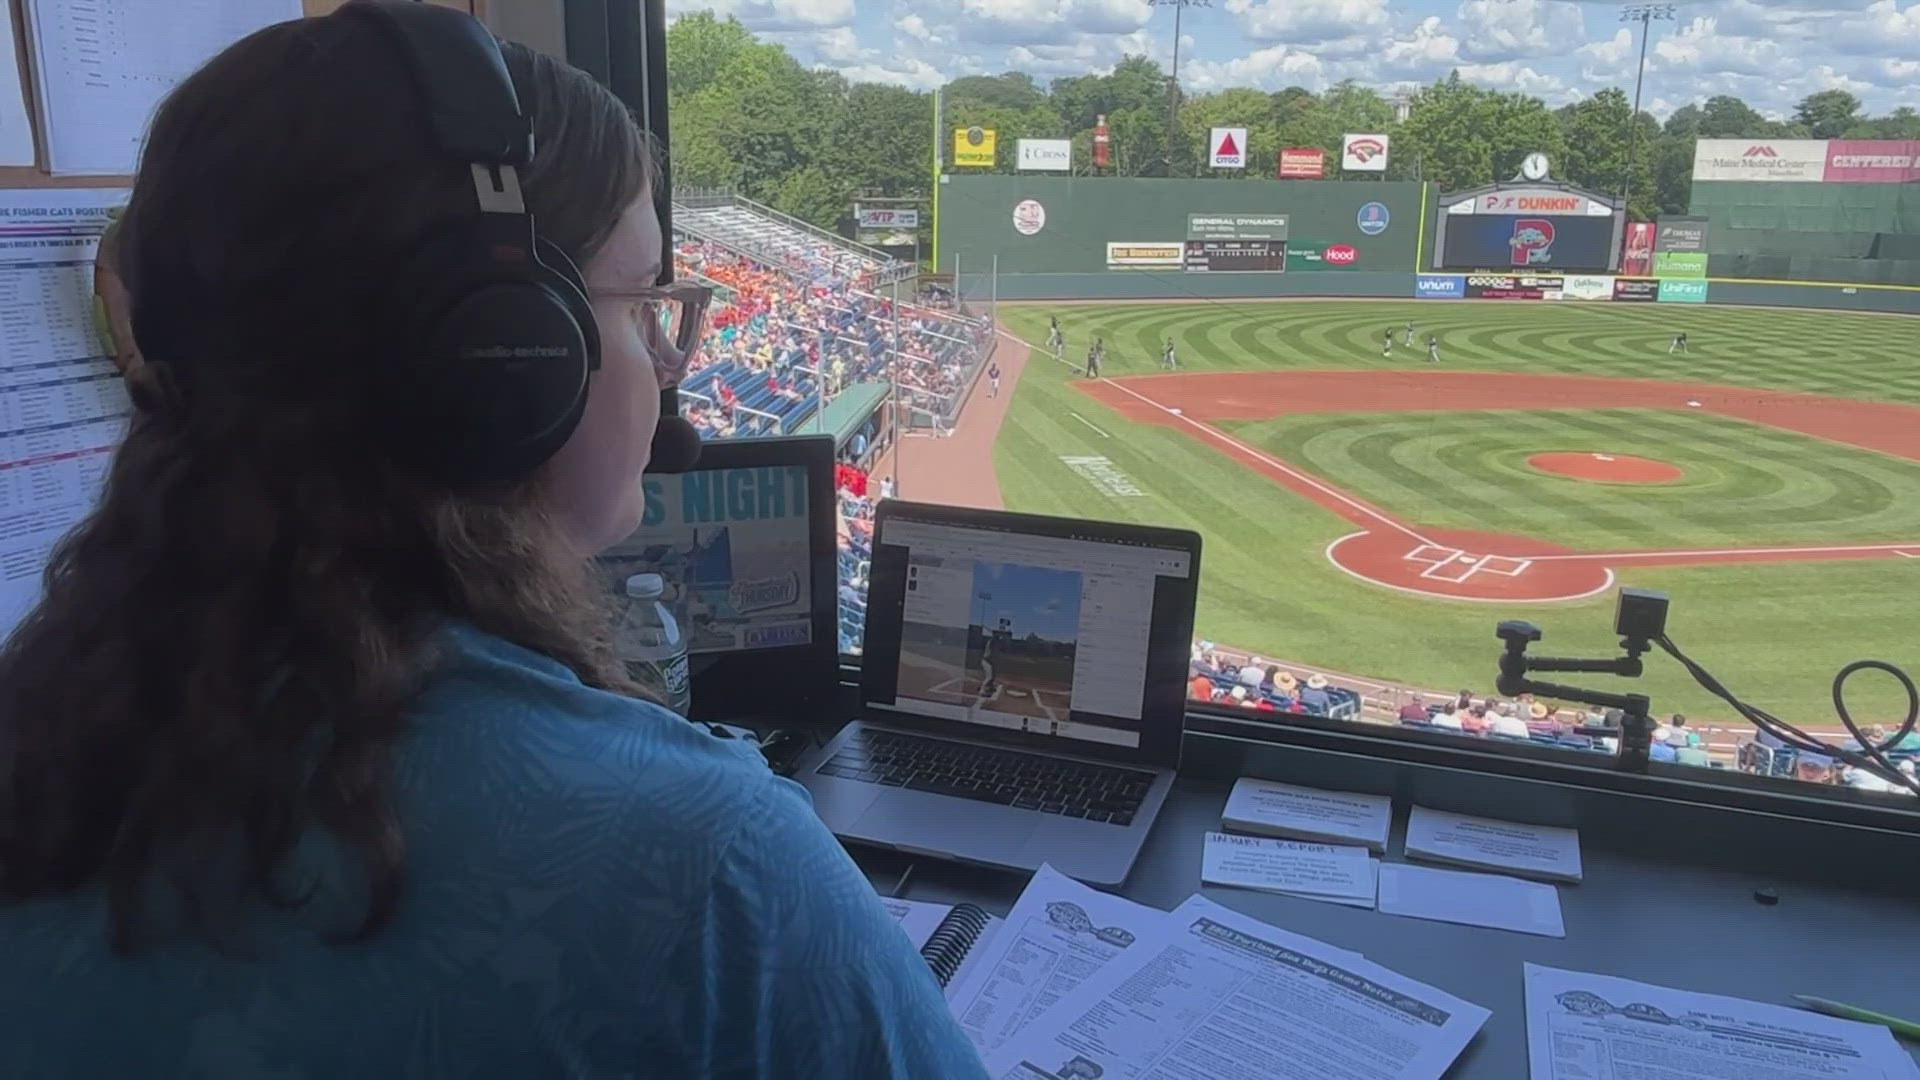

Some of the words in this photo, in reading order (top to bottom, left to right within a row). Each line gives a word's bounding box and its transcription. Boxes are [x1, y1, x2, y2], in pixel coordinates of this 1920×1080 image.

[1713, 158, 1740, 168] Maine
[1741, 158, 1776, 168] Medical
[1777, 159, 1806, 168] Center
[13, 208, 47, 216] FISHER
[50, 208, 73, 216] CATS
[1192, 218, 1235, 226] GENERAL
[1237, 218, 1285, 226] DYNAMICS
[1326, 250, 1355, 261] Hood
[1657, 262, 1701, 271] Humana
[1662, 283, 1703, 293] UniFirst
[681, 465, 809, 524] NIGHT
[1212, 834, 1260, 847] INJURY
[1276, 841, 1336, 853] REPORT
[1233, 934, 1279, 955] Portland
[1301, 958, 1329, 975] Dogs
[1329, 967, 1360, 985] Game
[1361, 982, 1394, 1001] Notes
